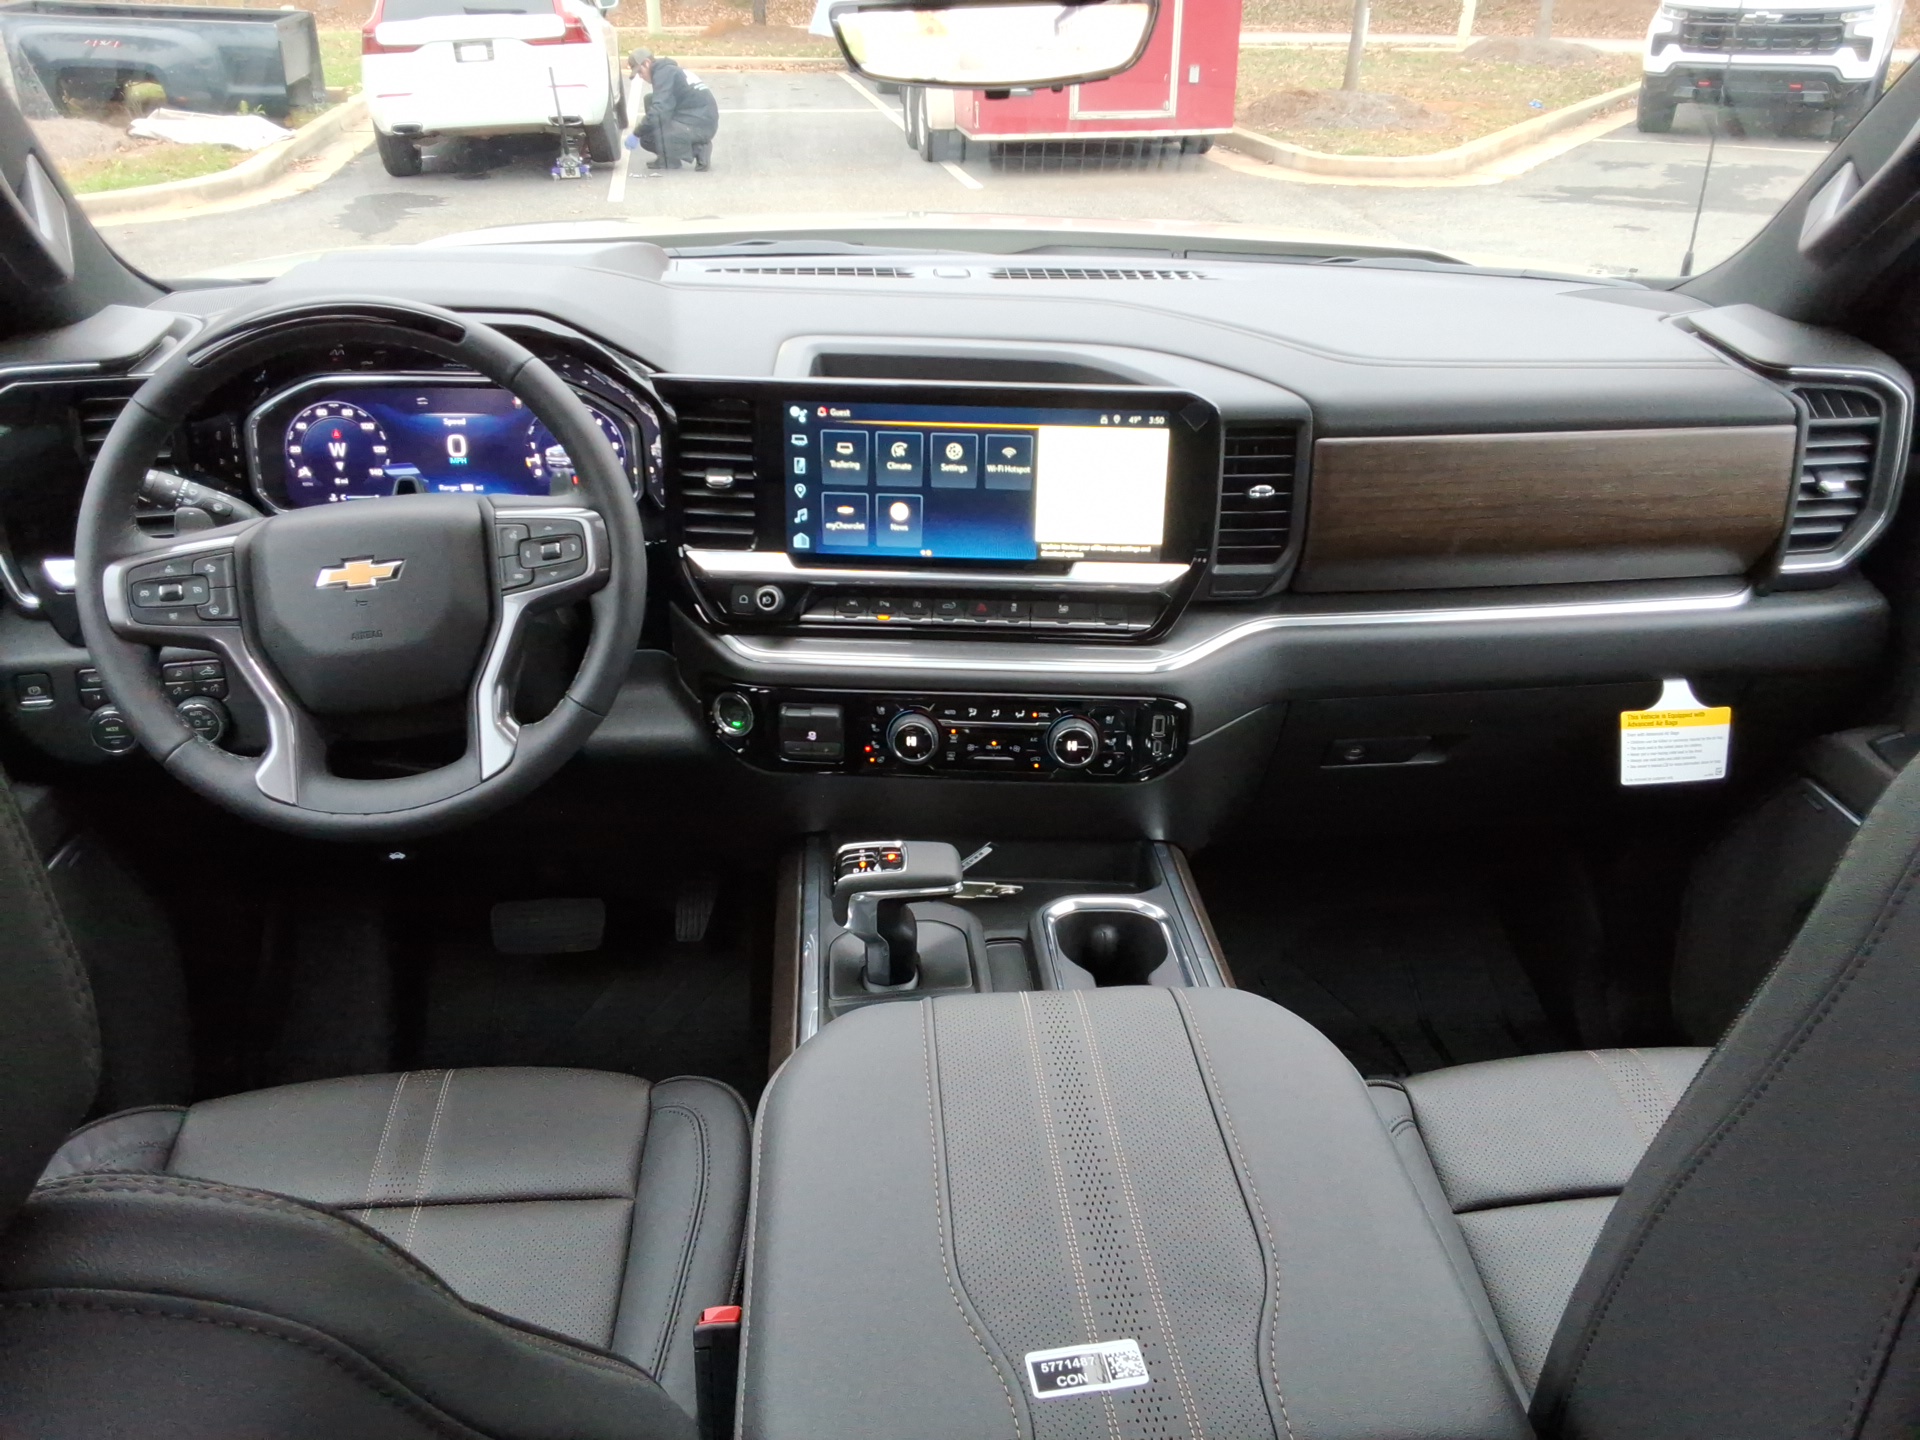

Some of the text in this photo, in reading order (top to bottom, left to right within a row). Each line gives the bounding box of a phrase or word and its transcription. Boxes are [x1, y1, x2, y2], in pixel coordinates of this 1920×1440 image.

[830, 408, 851, 418] Guest
[443, 417, 466, 427] Speed
[1149, 416, 1165, 424] 3:50
[328, 442, 346, 458] W
[447, 434, 467, 458] 0
[449, 457, 468, 465] MPH
[886, 461, 913, 471] Climate
[940, 463, 968, 474] Settings
[987, 464, 1031, 475] Wi-Fi Hotspot
[890, 523, 909, 532] News
[1667, 712, 1693, 720] Equipped
[1665, 719, 1678, 727] Bags
[1057, 1373, 1089, 1387] CON
